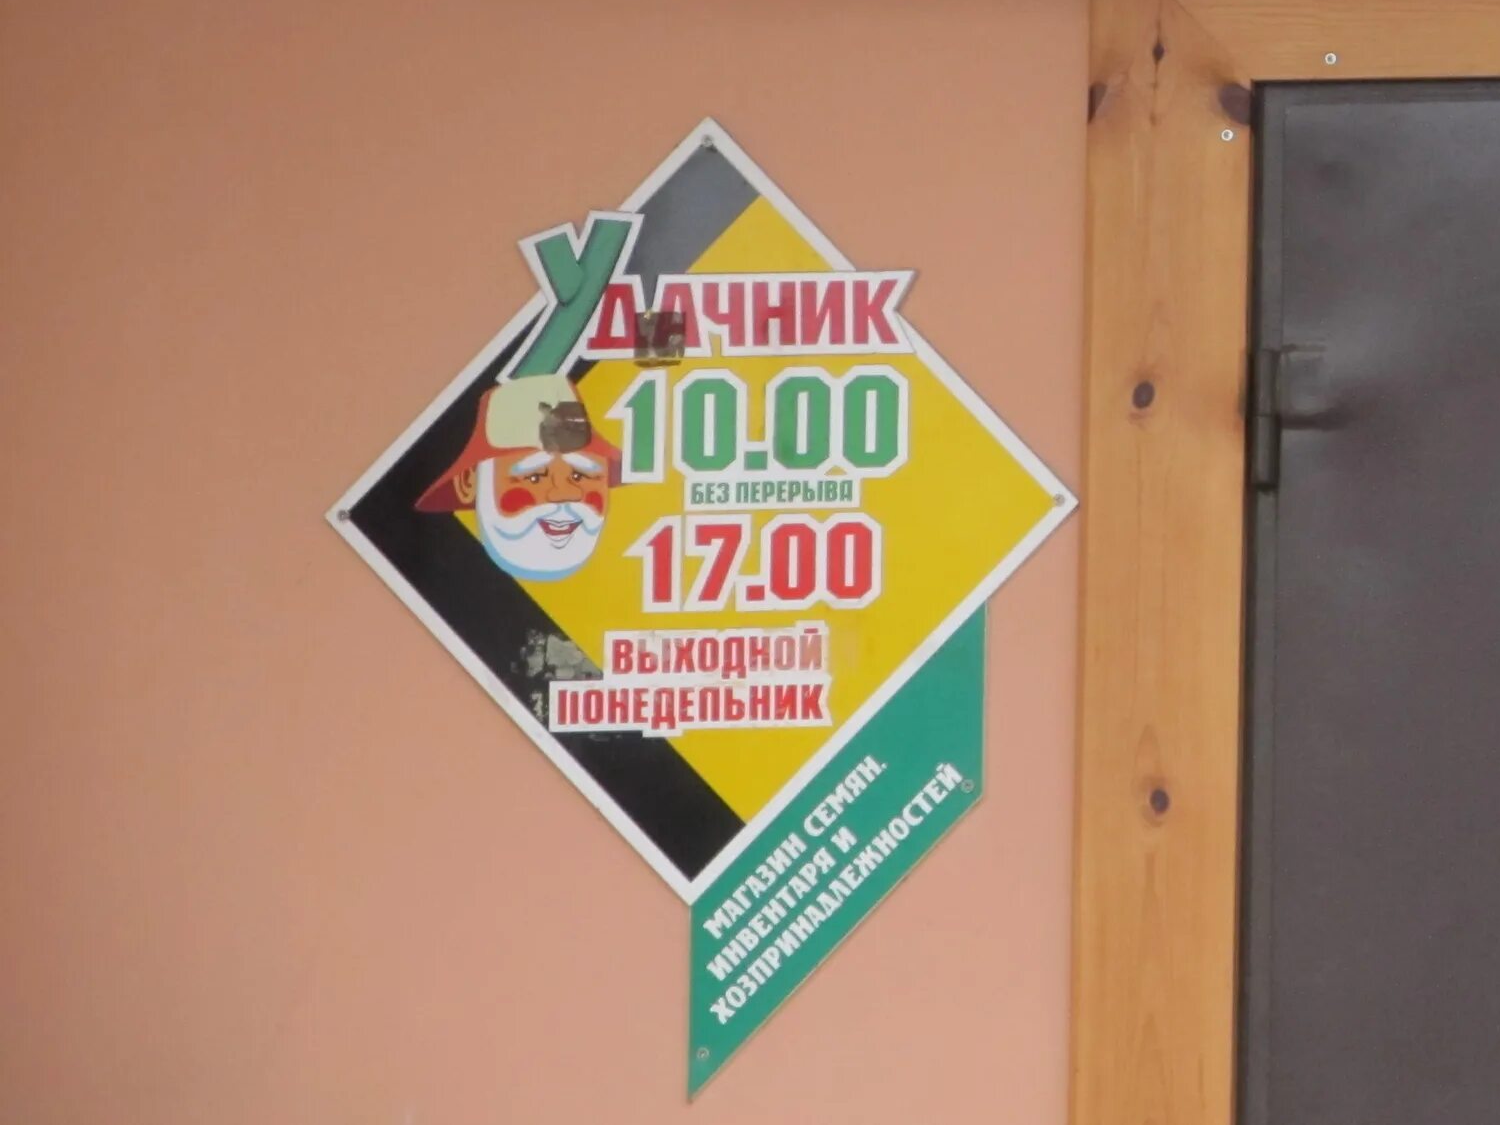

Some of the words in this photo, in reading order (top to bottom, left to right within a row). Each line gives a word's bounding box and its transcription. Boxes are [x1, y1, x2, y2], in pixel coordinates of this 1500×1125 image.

[514, 219, 900, 375] УДАЧНИК
[624, 374, 900, 473] 10.00
[689, 481, 730, 505] БЕЗ
[735, 479, 854, 504] ПЕРЕРЫВА
[647, 521, 873, 603] 17.00
[612, 627, 823, 679] ВЫХОДНОЙ
[702, 832, 807, 939] МАГАЗИН
[706, 847, 837, 982] ИНВЕНТАРЯ
[830, 826, 858, 854] И
[709, 761, 964, 1025] ХОЗПРИНАДЛЕЖНОСТЕЙ
